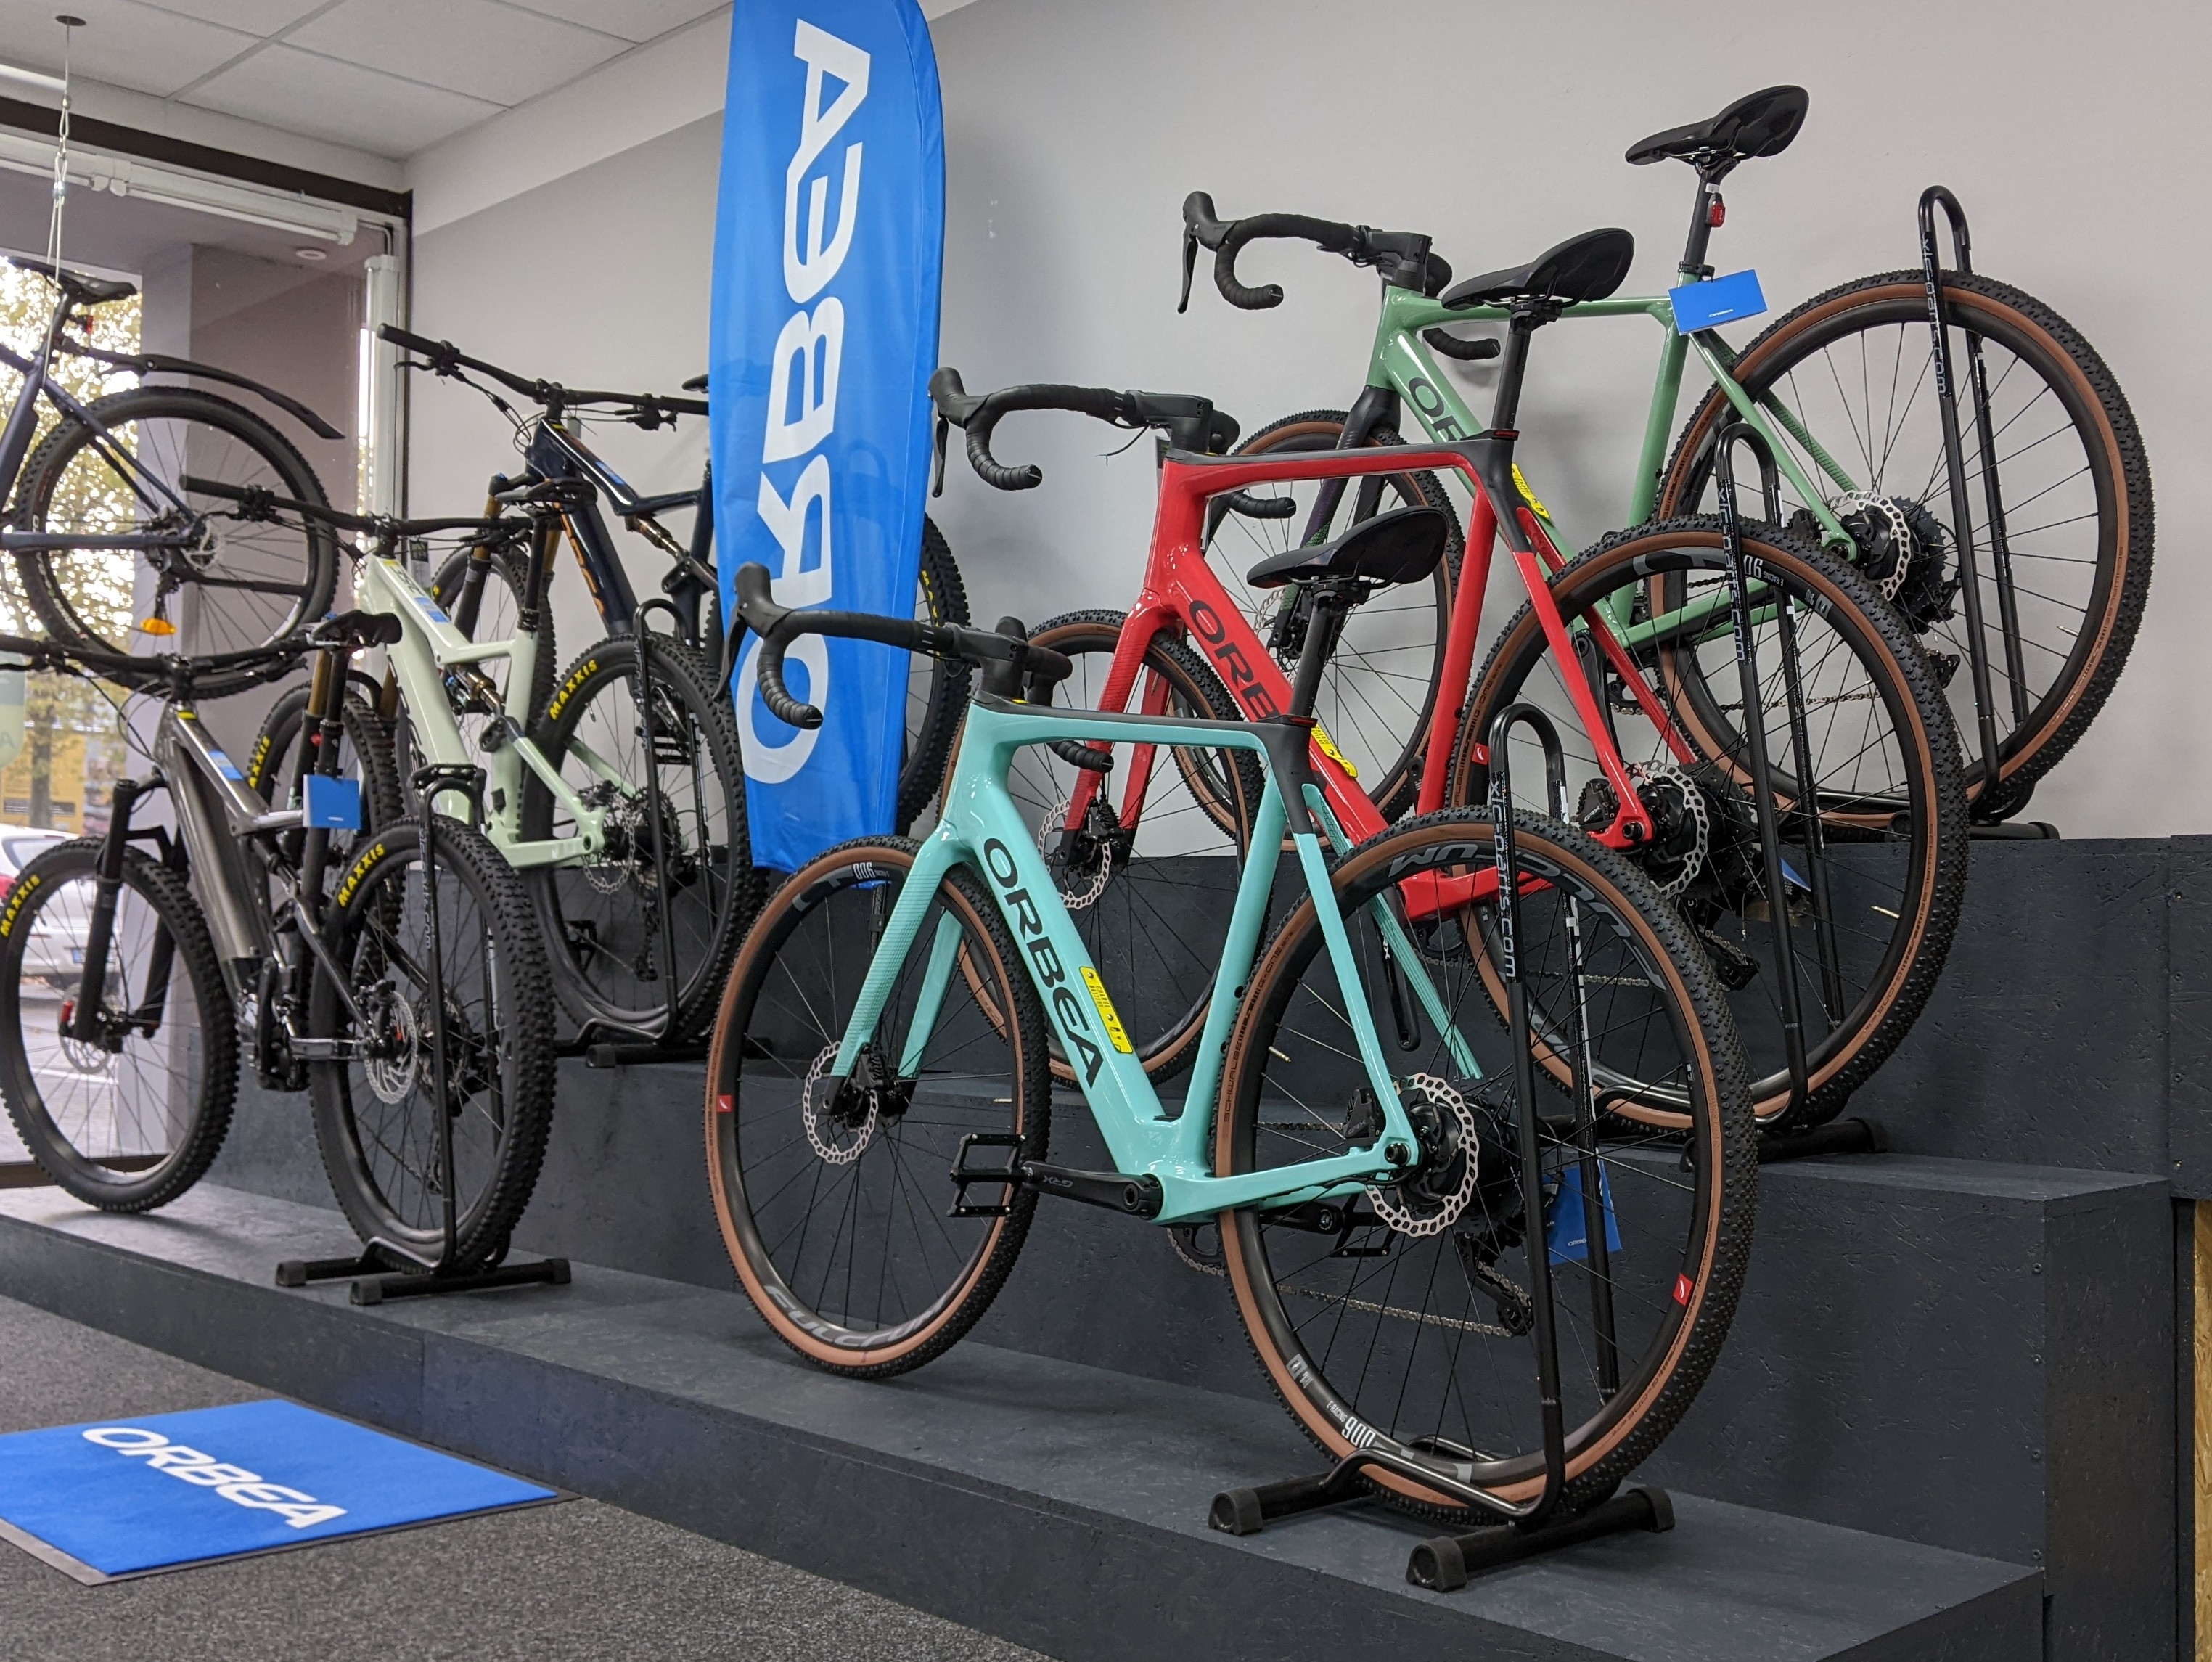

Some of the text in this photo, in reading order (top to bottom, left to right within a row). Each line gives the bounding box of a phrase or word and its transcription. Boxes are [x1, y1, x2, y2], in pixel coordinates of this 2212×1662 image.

[737, 18, 871, 785] ORBEA
[1743, 554, 1764, 578] 90
[549, 658, 597, 720] MAXXIS
[1189, 599, 1282, 720] ORB
[338, 843, 384, 907] MAXXIS
[853, 861, 876, 880] 900
[1489, 777, 1517, 979] xlc-parts.com
[0, 874, 41, 937] MAXXIS
[983, 837, 1105, 1090] ORBEA
[1224, 1039, 1242, 1123] SCHWALBE
[1259, 948, 1283, 988] G-ONE
[1043, 1174, 1073, 1188] GRX
[1326, 1400, 1376, 1449] E-RACING 900
[81, 1427, 348, 1529] ORBEA
